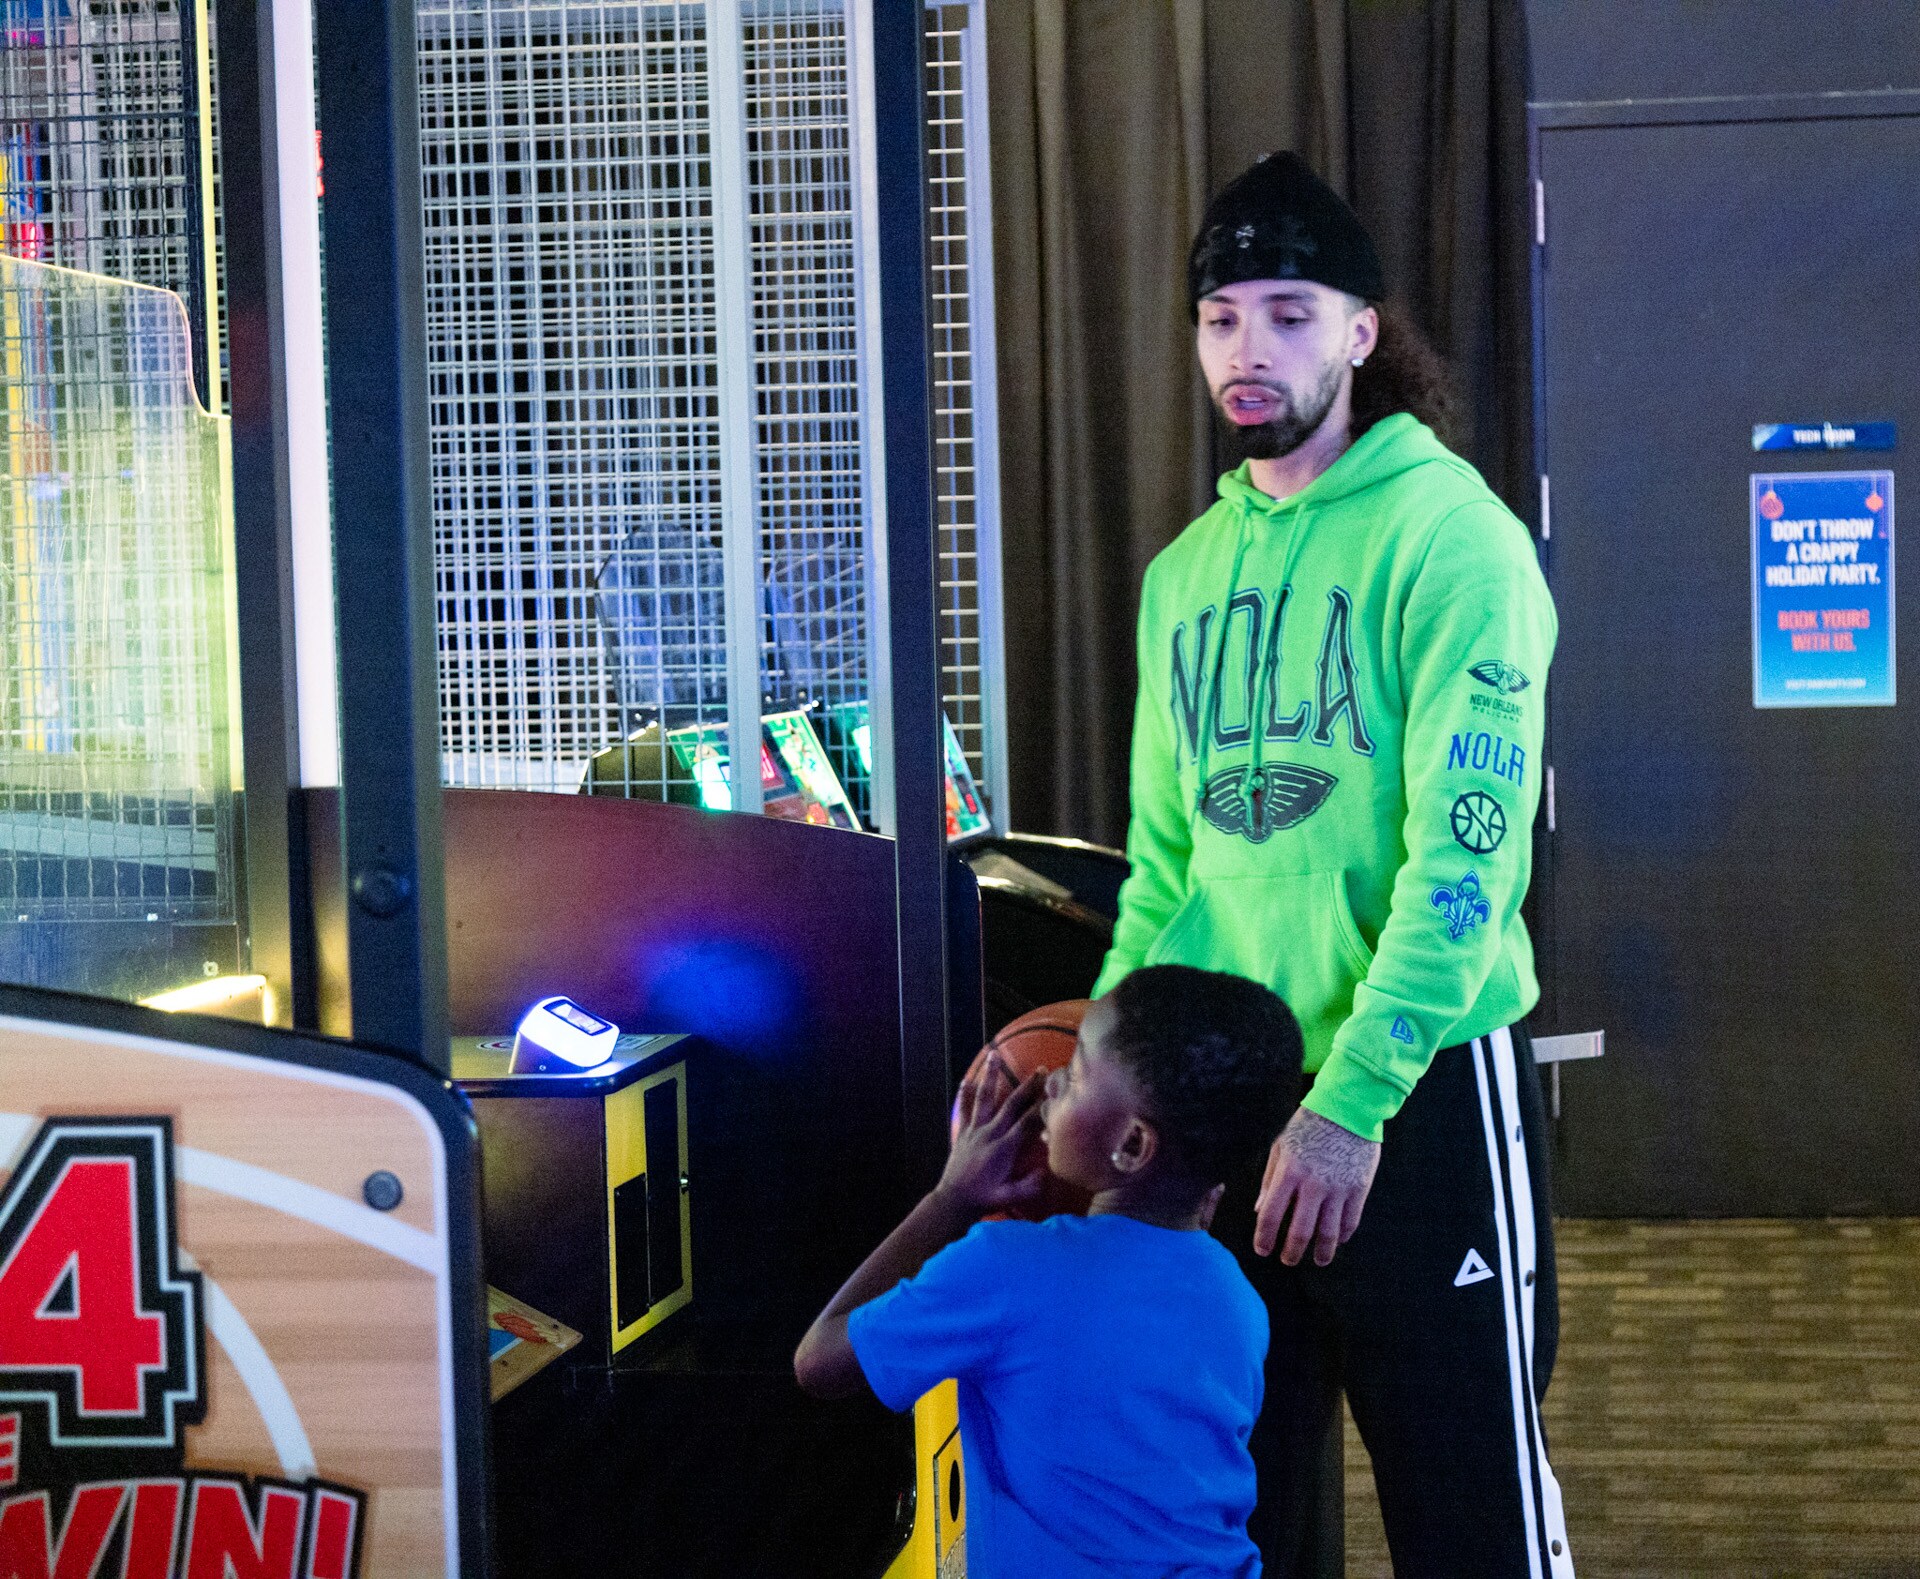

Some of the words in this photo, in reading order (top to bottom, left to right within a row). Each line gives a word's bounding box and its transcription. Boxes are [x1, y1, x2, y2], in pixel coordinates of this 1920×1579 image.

[1771, 520, 1817, 542] DON'T
[1819, 518, 1874, 541] THROW
[1786, 542, 1799, 563] A
[1800, 541, 1859, 563] CRAPPY
[1765, 564, 1827, 587] HOLIDAY
[1829, 562, 1881, 586] PARTY.
[1778, 610, 1818, 630] BOOK
[1821, 608, 1870, 629] YOURS
[1792, 632, 1830, 651] WITH
[1171, 583, 1376, 770] NOLA
[1470, 694, 1493, 708] NEW
[1492, 698, 1524, 717] ORLEANS
[1447, 732, 1526, 787] NOLA
[0, 1126, 199, 1448] 4
